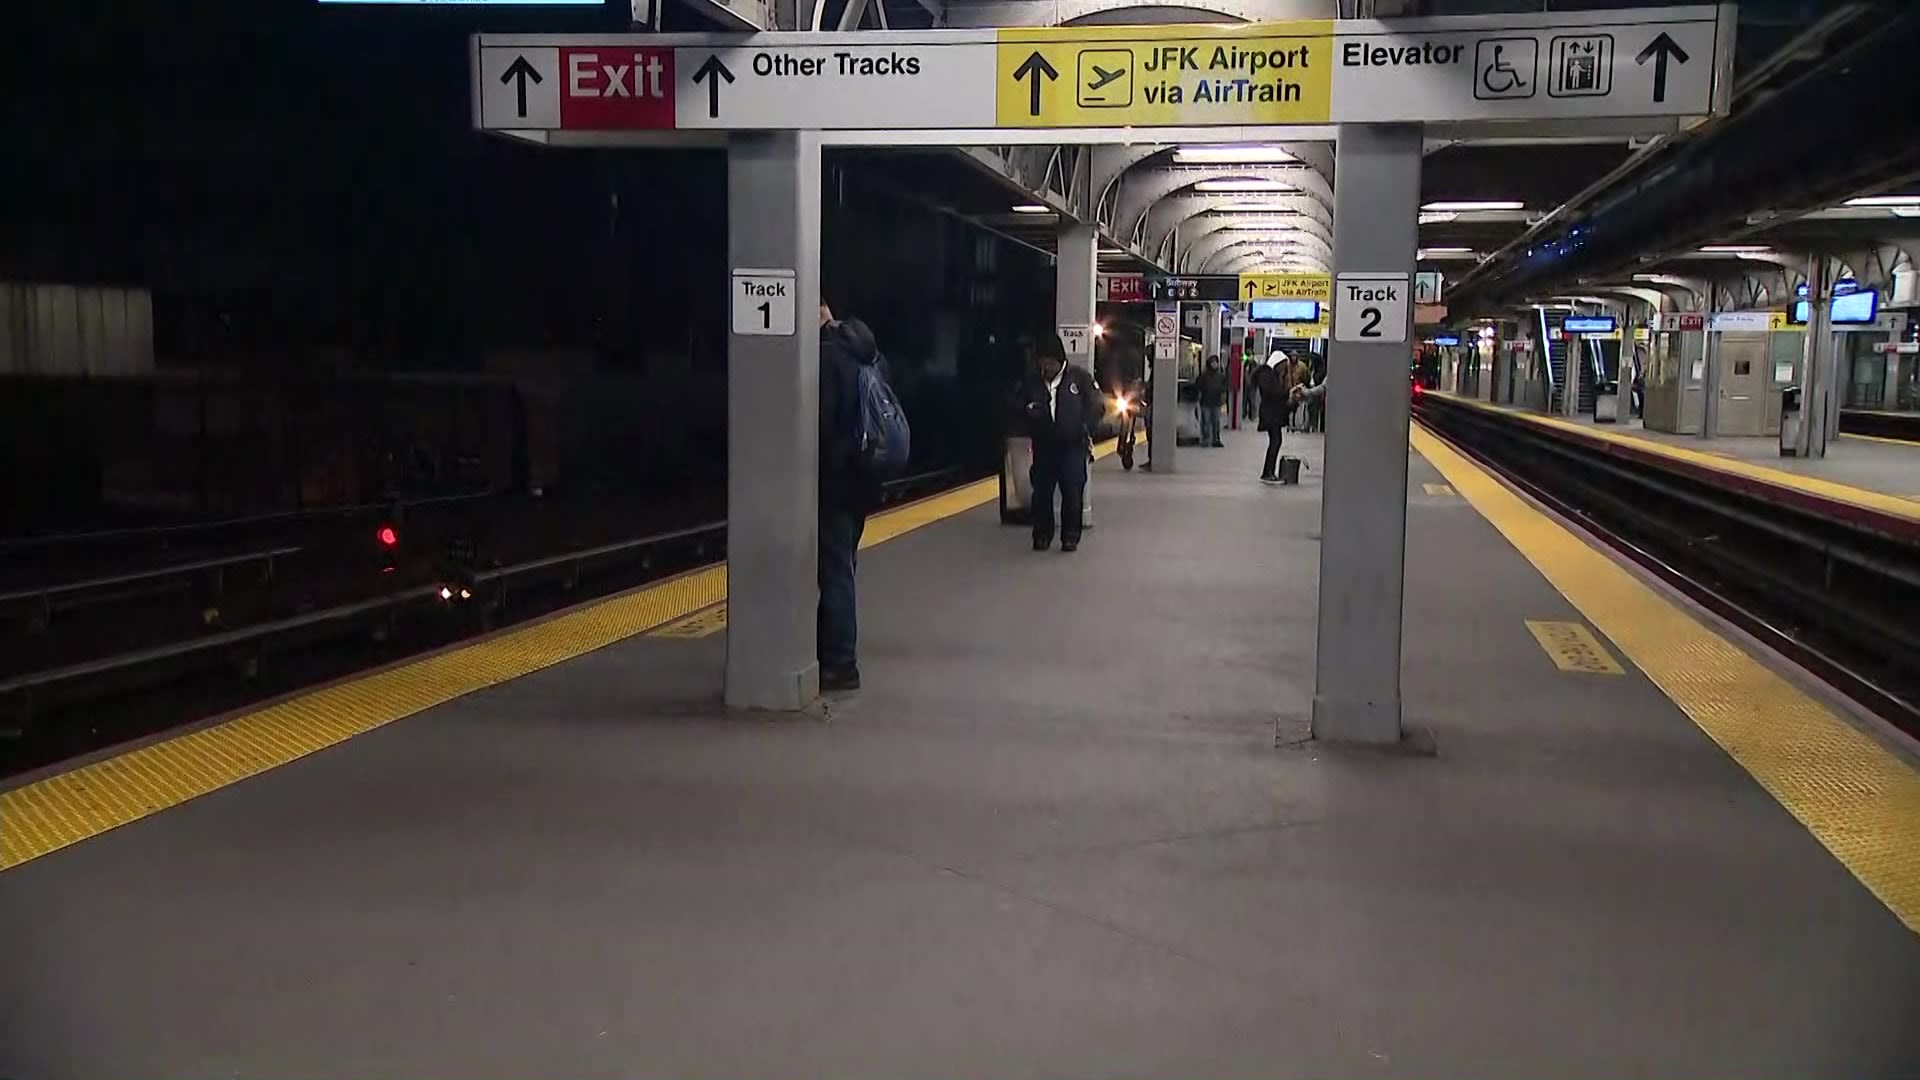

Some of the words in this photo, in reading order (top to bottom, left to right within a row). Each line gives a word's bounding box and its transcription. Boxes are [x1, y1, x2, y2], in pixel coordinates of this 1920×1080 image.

[752, 52, 826, 77] Other
[833, 51, 921, 76] Tracks
[1144, 46, 1199, 72] JFK
[1208, 44, 1310, 76] Airport
[1342, 42, 1465, 67] Elevator
[568, 53, 664, 97] Exit
[1143, 80, 1183, 105] via
[1192, 78, 1302, 104] AirTrain
[741, 280, 787, 297] Track
[1110, 278, 1140, 293] Exit
[1281, 279, 1298, 287] JFK
[1300, 279, 1329, 289] Airport
[1281, 288, 1294, 296] via
[1295, 288, 1328, 297] AirTrain
[1346, 285, 1397, 301] Track
[757, 301, 770, 329] 1
[1359, 307, 1382, 338] 2
[1063, 329, 1084, 338] Track
[1070, 338, 1077, 353] 1
